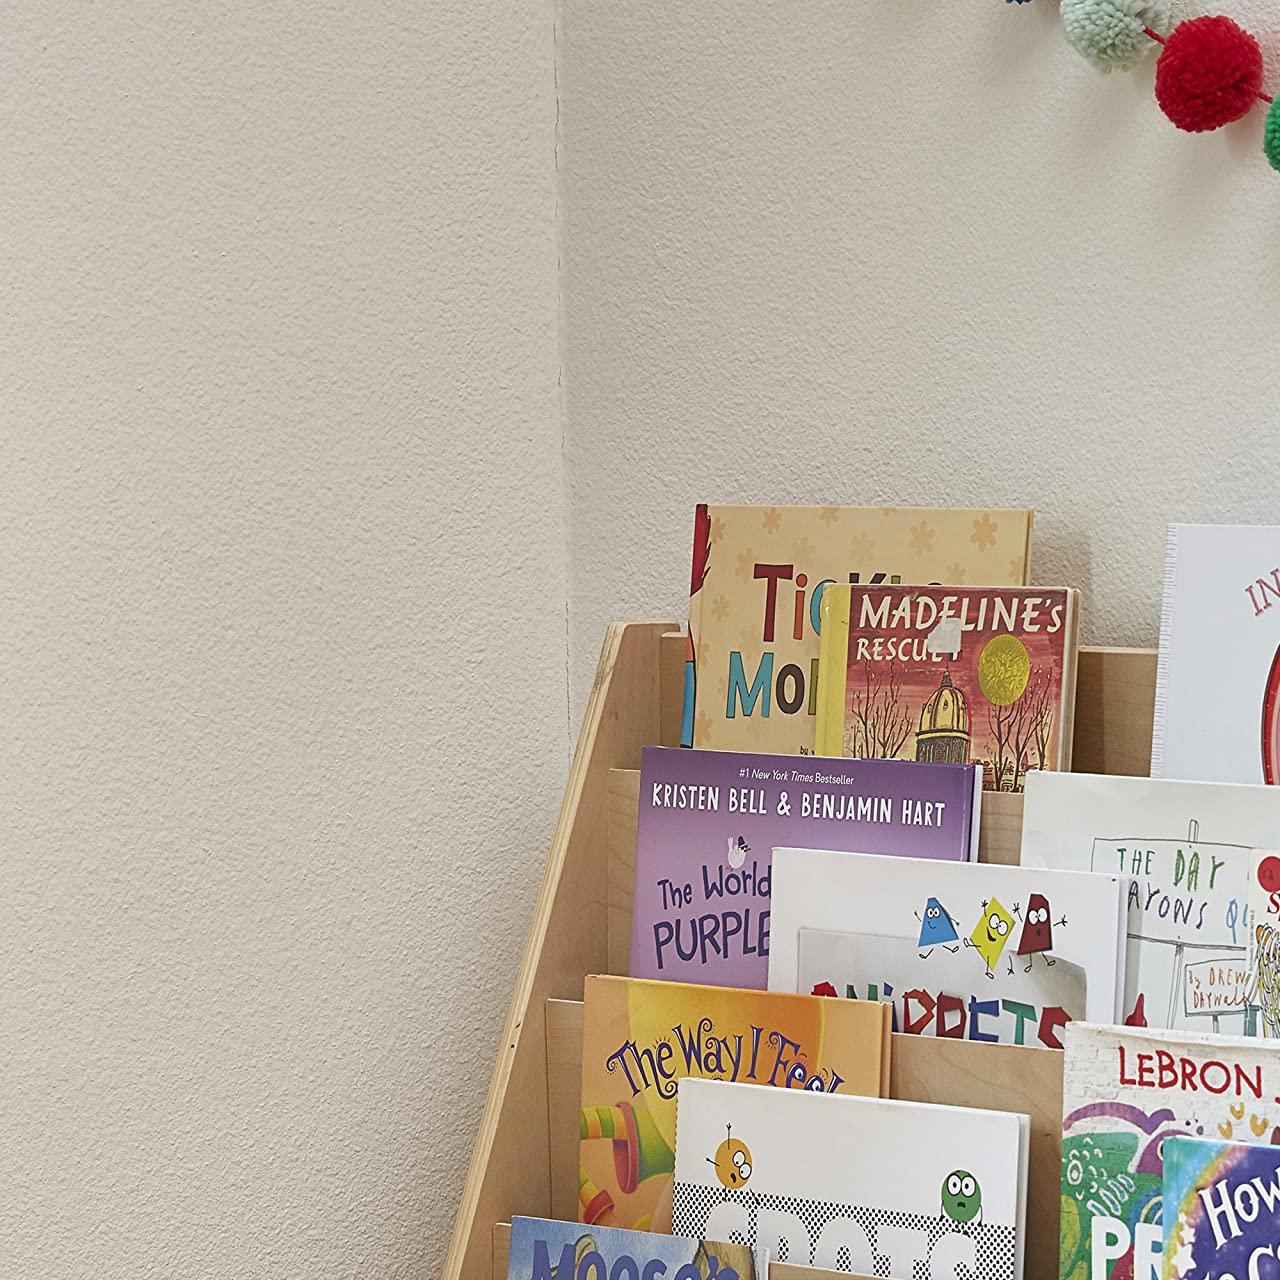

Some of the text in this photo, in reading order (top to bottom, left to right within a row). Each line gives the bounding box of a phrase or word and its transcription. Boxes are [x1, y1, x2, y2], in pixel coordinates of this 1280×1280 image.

[856, 637, 943, 662] RESCU
[739, 768, 854, 785] #1 New York Times Bestseller
[652, 783, 945, 827] KRISTEN BELL & BENJAMIN HART
[657, 860, 771, 910] The World
[1117, 848, 1225, 892] THE DAY
[652, 909, 770, 970] PURPLE
[606, 1039, 678, 1099] The
[672, 1018, 743, 1082] Way
[746, 1024, 764, 1079] I
